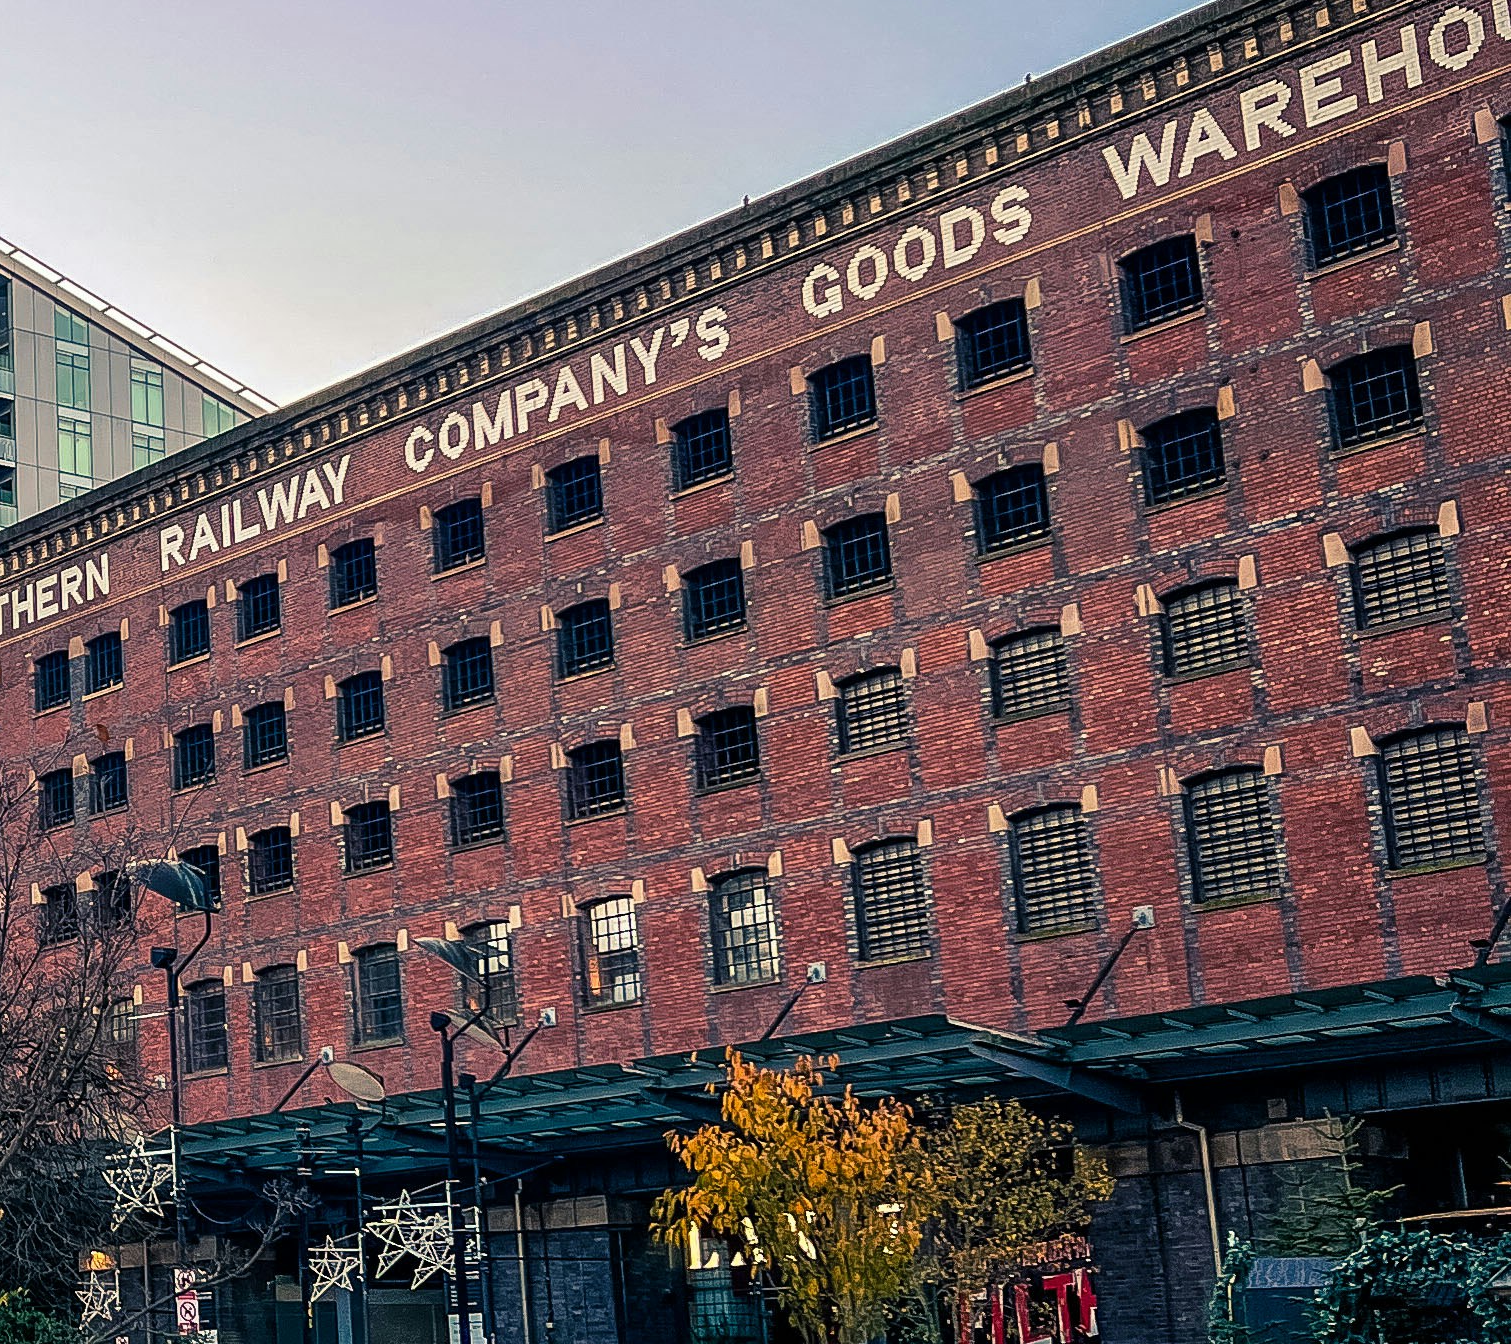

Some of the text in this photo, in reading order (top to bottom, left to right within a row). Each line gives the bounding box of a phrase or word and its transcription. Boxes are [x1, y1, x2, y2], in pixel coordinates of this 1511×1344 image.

[160, 455, 350, 572] RAILWAY
[404, 305, 730, 473] COMPANY'S
[801, 185, 1032, 319] GOODS
